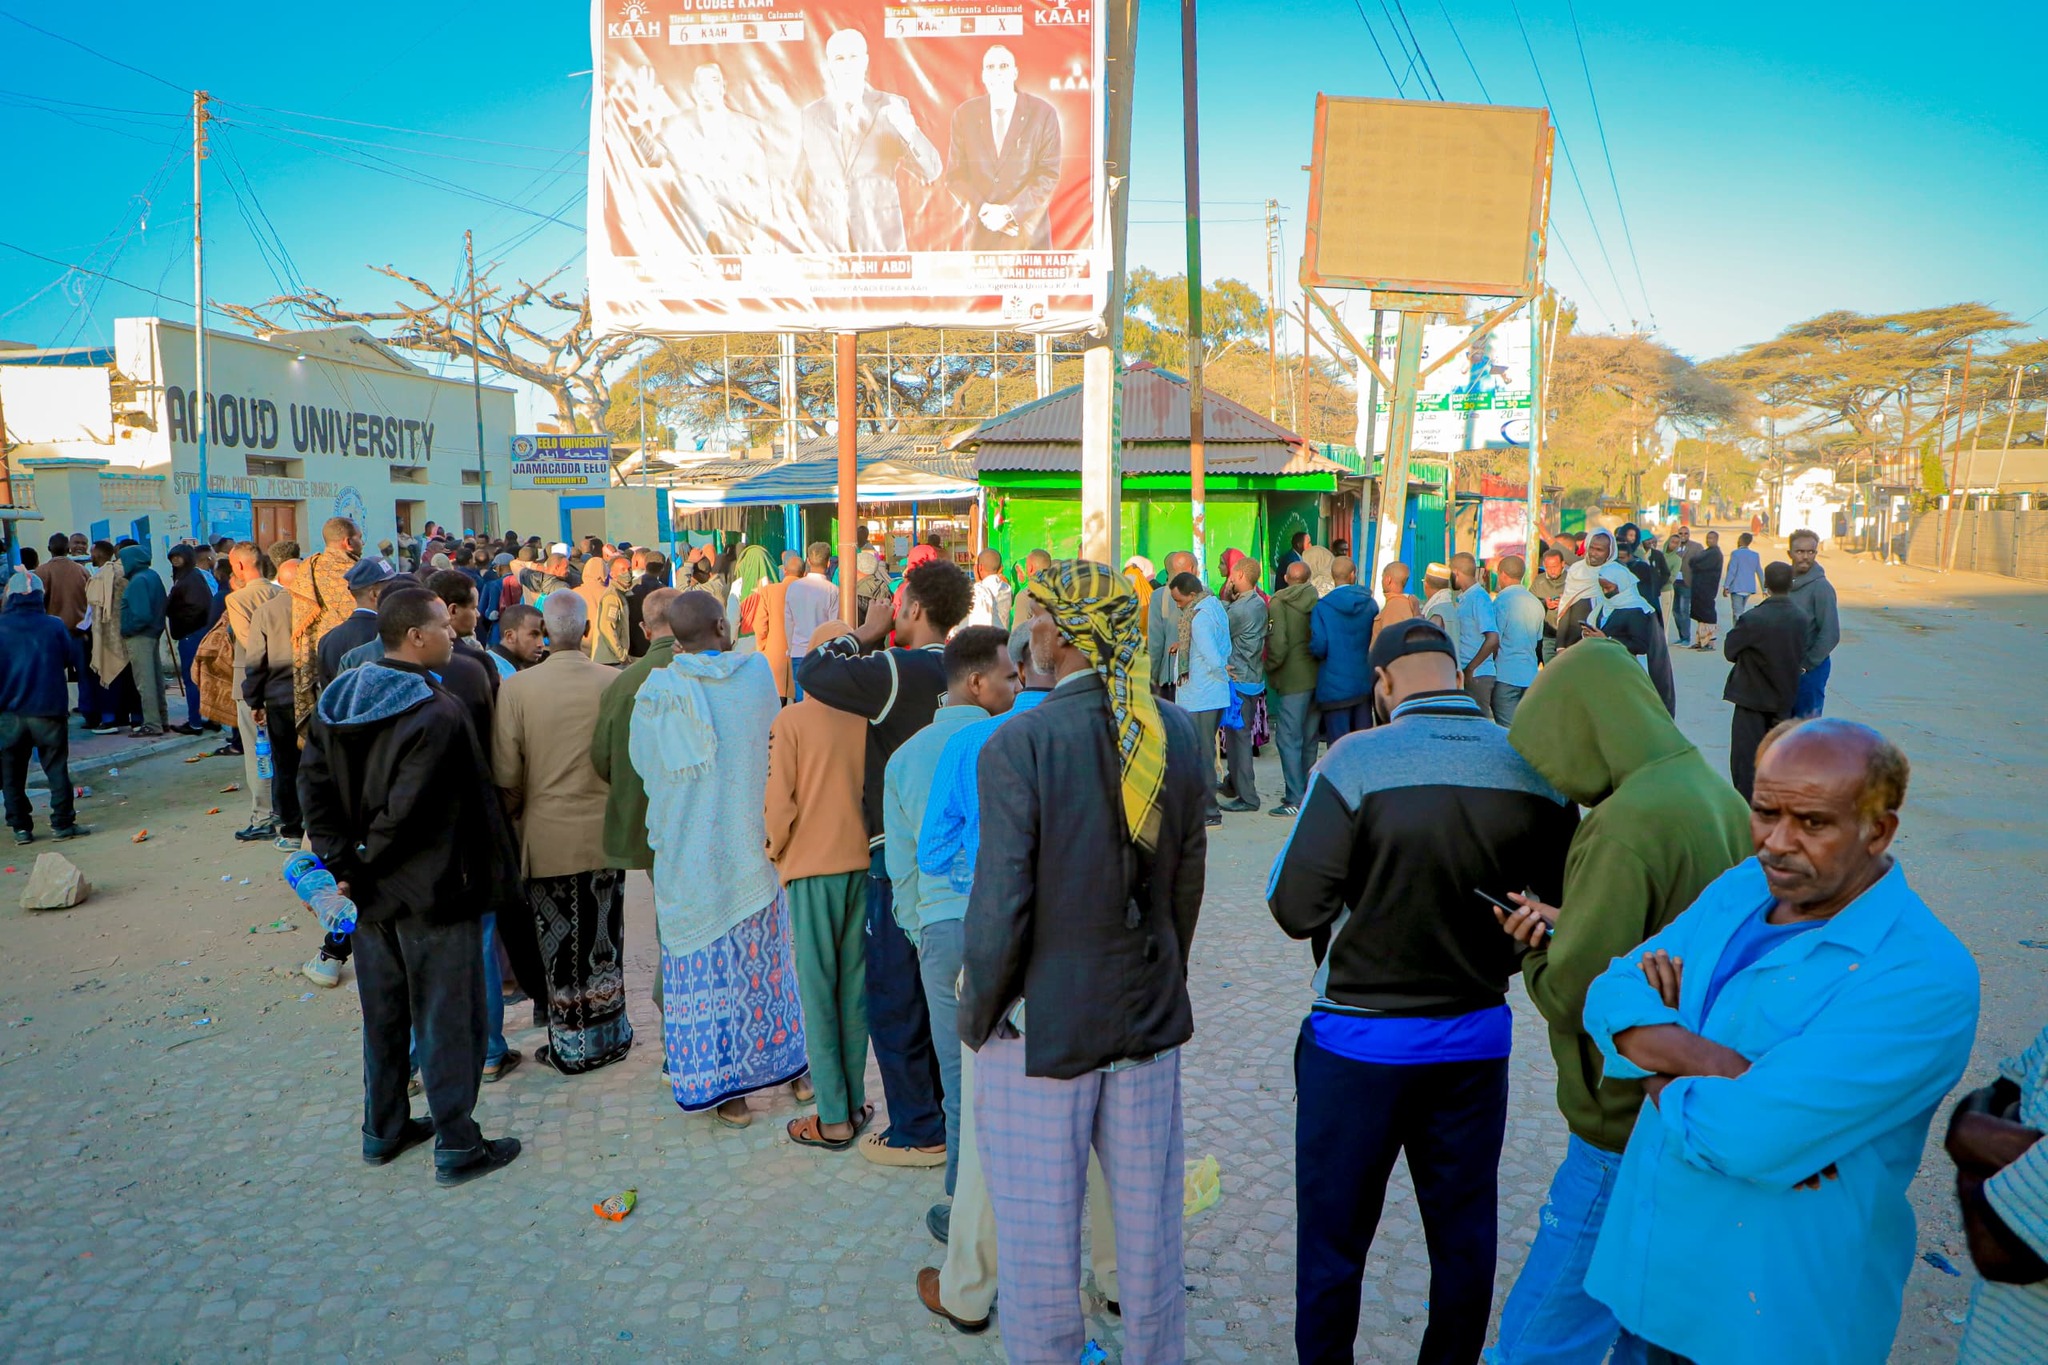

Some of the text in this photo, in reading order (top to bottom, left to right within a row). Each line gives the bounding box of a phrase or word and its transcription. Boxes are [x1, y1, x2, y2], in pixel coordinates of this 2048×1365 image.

[1035, 9, 1090, 24] KAAH
[608, 21, 661, 36] KAAH
[998, 18, 1006, 31] X
[680, 23, 788, 42] 6 KAAH X
[290, 403, 434, 461] UNIVERSITY
[537, 437, 608, 449] EELO UNIVERSITY
[513, 462, 607, 474] JAAMACADDA EELO
